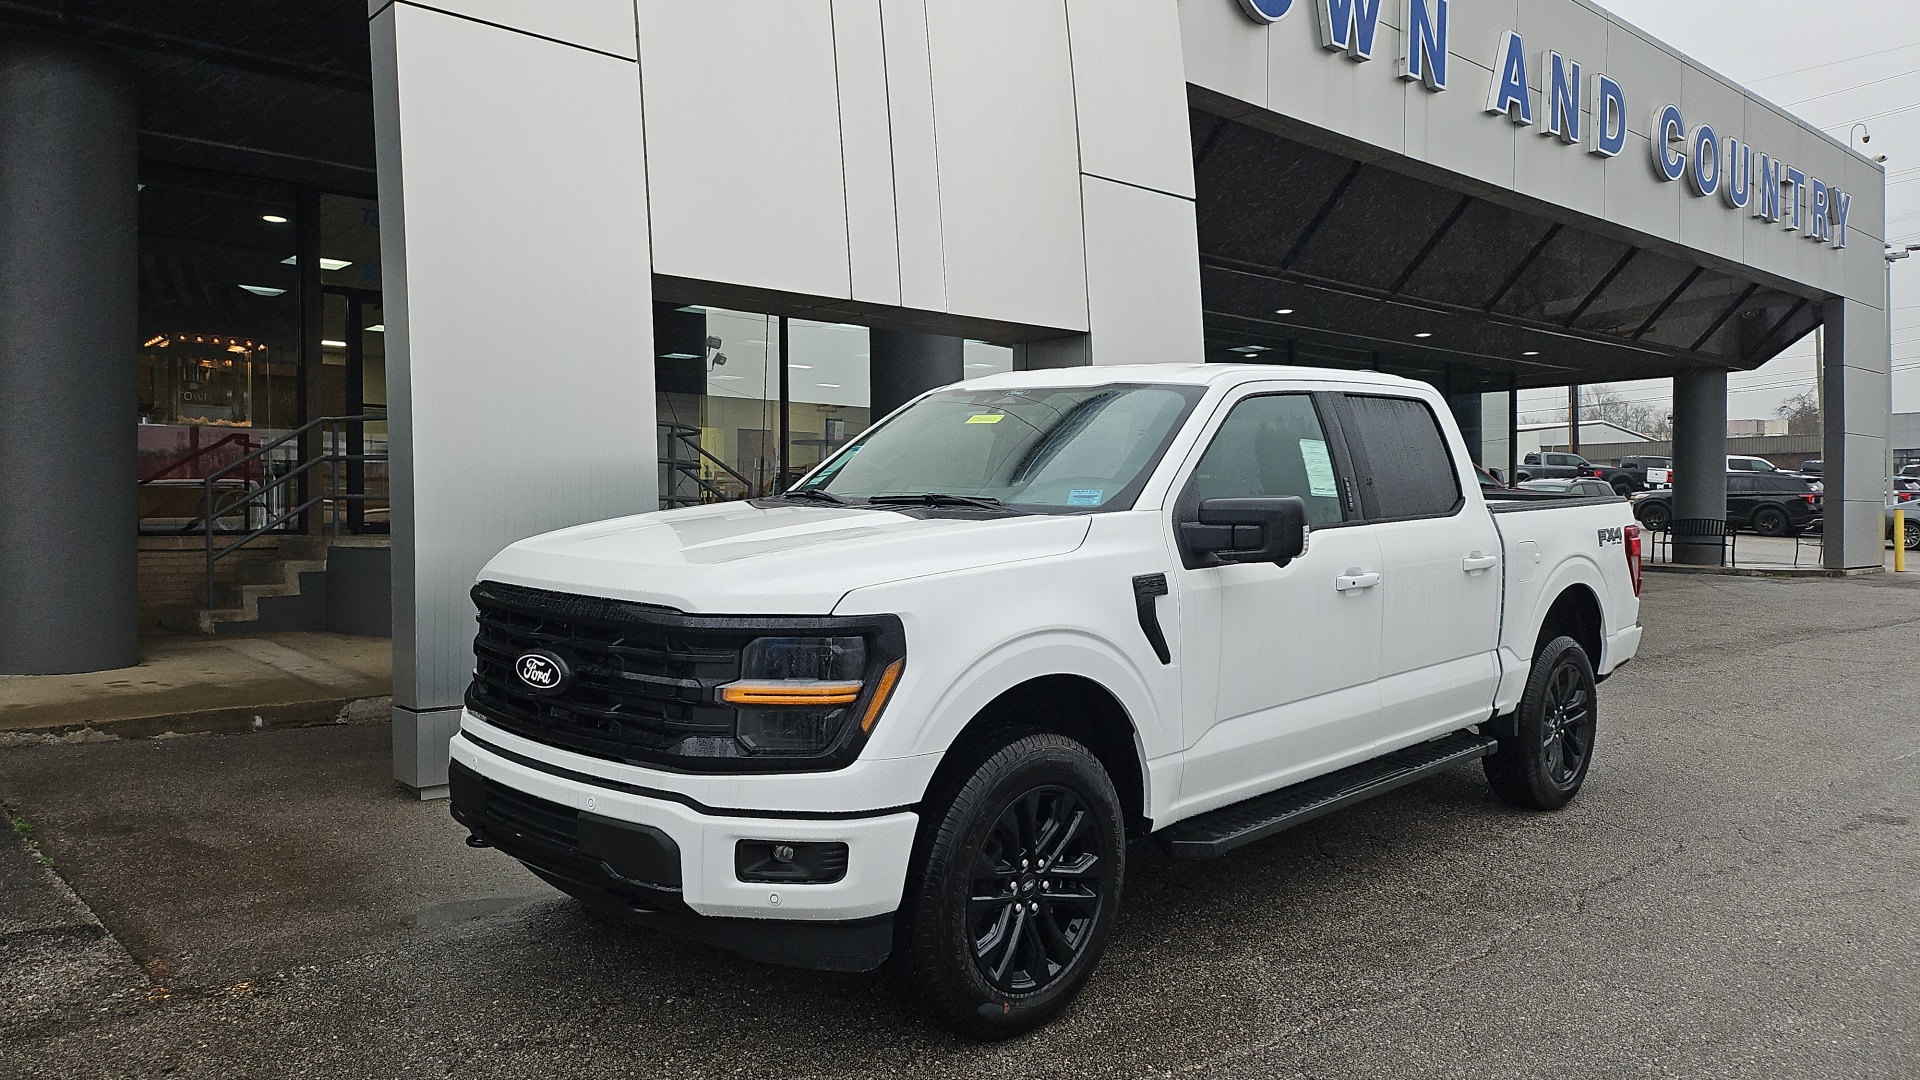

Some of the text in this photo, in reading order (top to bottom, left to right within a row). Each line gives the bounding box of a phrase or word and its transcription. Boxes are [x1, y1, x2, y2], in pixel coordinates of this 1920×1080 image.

[1237, 0, 1852, 249] WN AND COUNTRY
[1597, 526, 1622, 547] FX4
[523, 658, 552, 684] Ford
